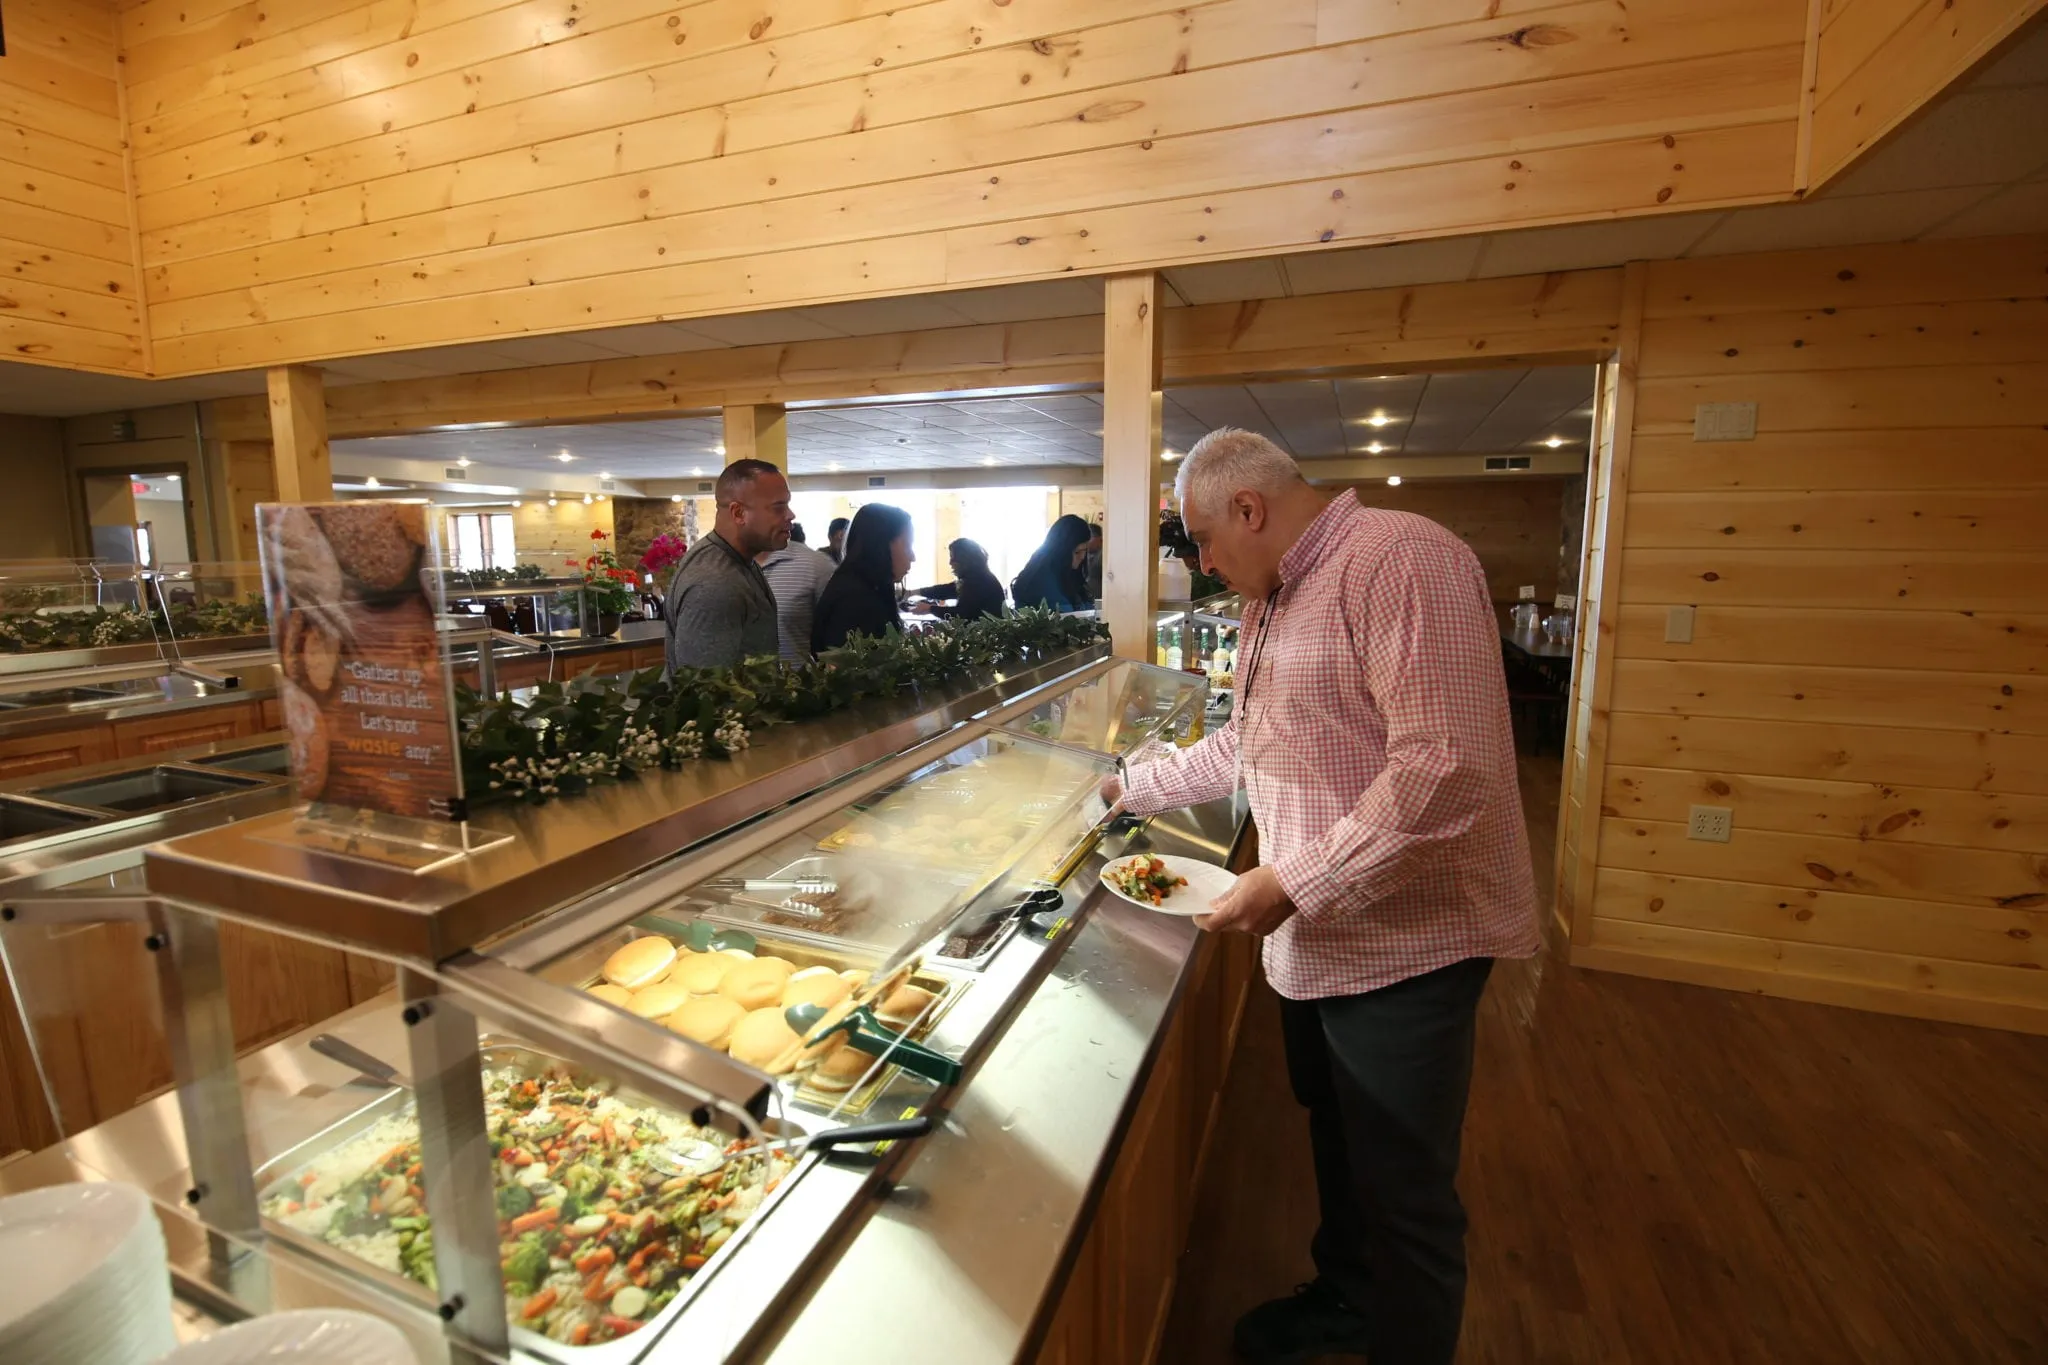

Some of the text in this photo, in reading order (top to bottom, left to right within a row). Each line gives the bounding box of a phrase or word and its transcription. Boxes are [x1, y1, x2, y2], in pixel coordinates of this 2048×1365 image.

[403, 669, 422, 688] up
[341, 686, 358, 703] all
[360, 687, 387, 705] that
[390, 691, 403, 707] is
[395, 720, 418, 735] not
[346, 739, 400, 756] waste
